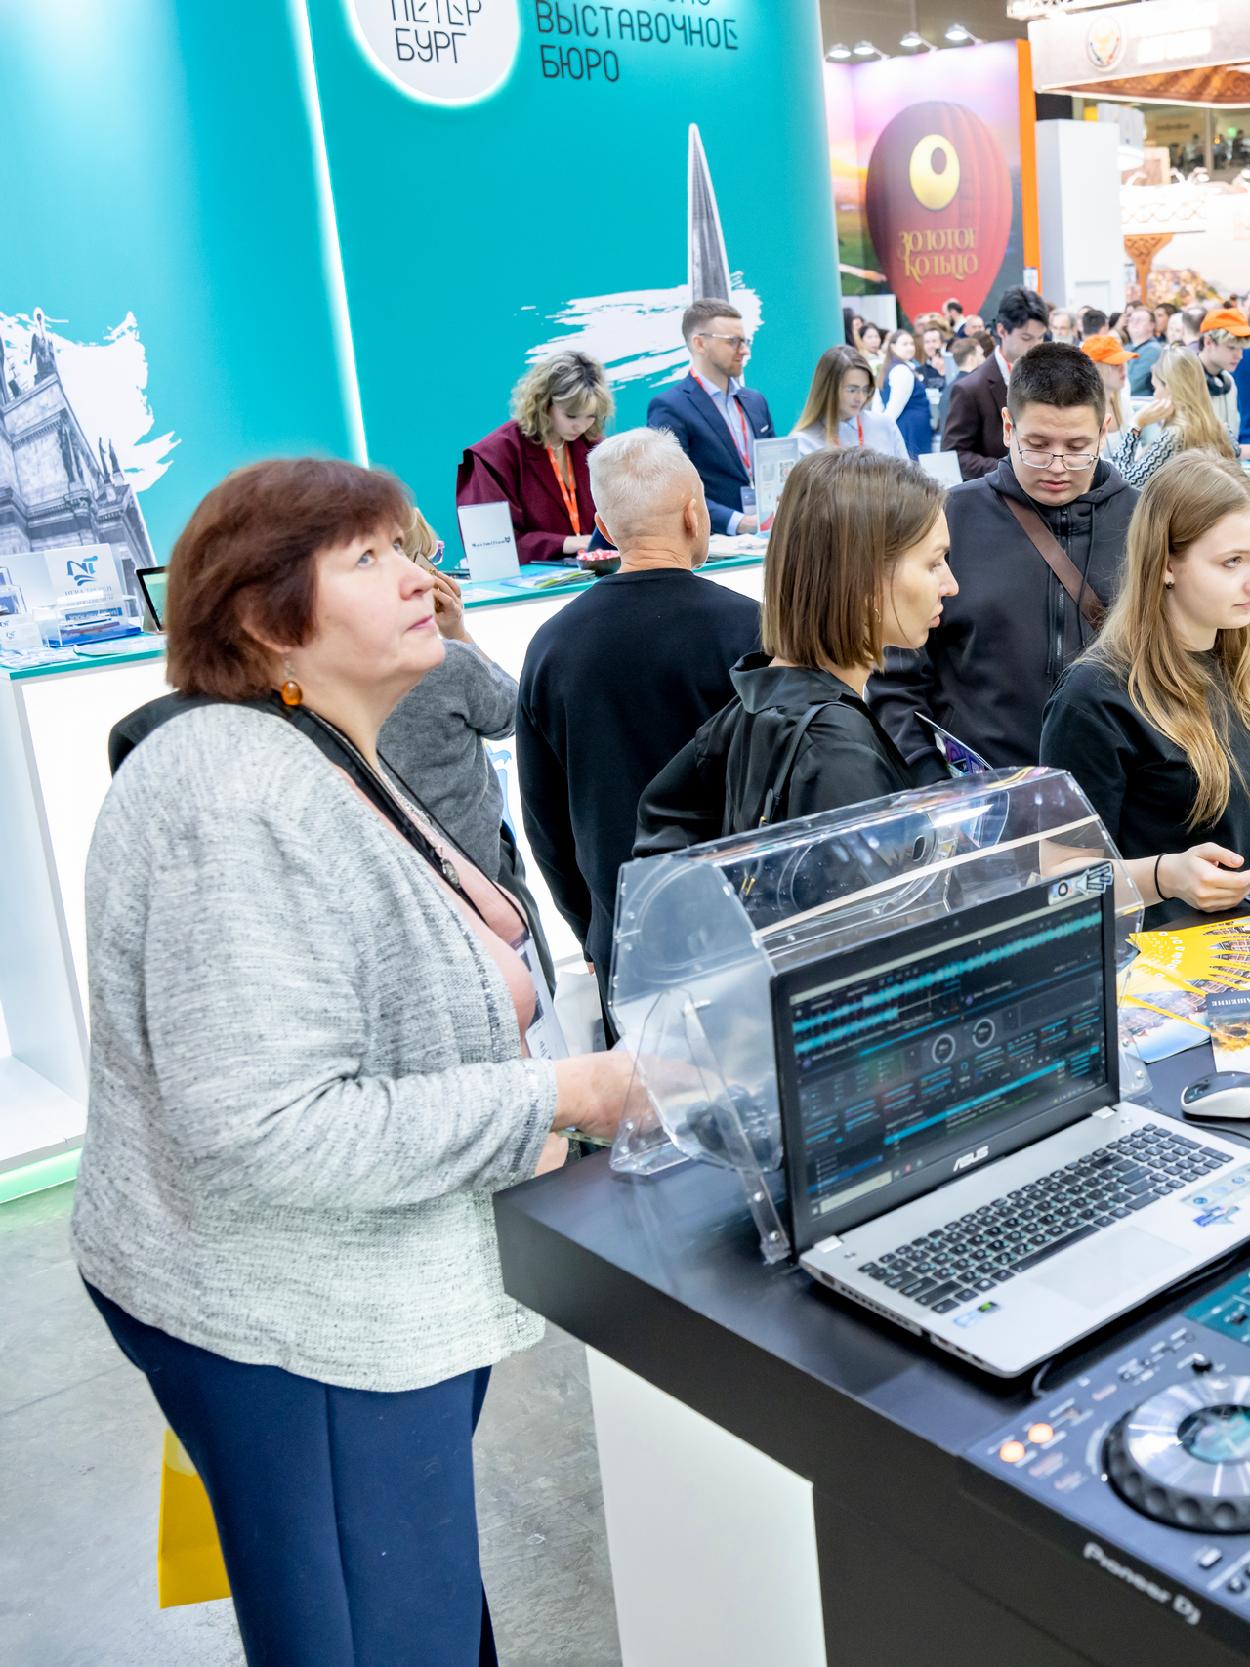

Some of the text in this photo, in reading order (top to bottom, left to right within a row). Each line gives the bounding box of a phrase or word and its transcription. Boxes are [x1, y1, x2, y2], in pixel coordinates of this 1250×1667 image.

[535, 1, 739, 50] ВЫСТАВОЧНОЕ
[394, 28, 467, 63] БУРГ
[540, 45, 619, 82] БЮРО
[953, 1145, 989, 1172] ASUS
[1083, 1541, 1171, 1604] Pioneer
